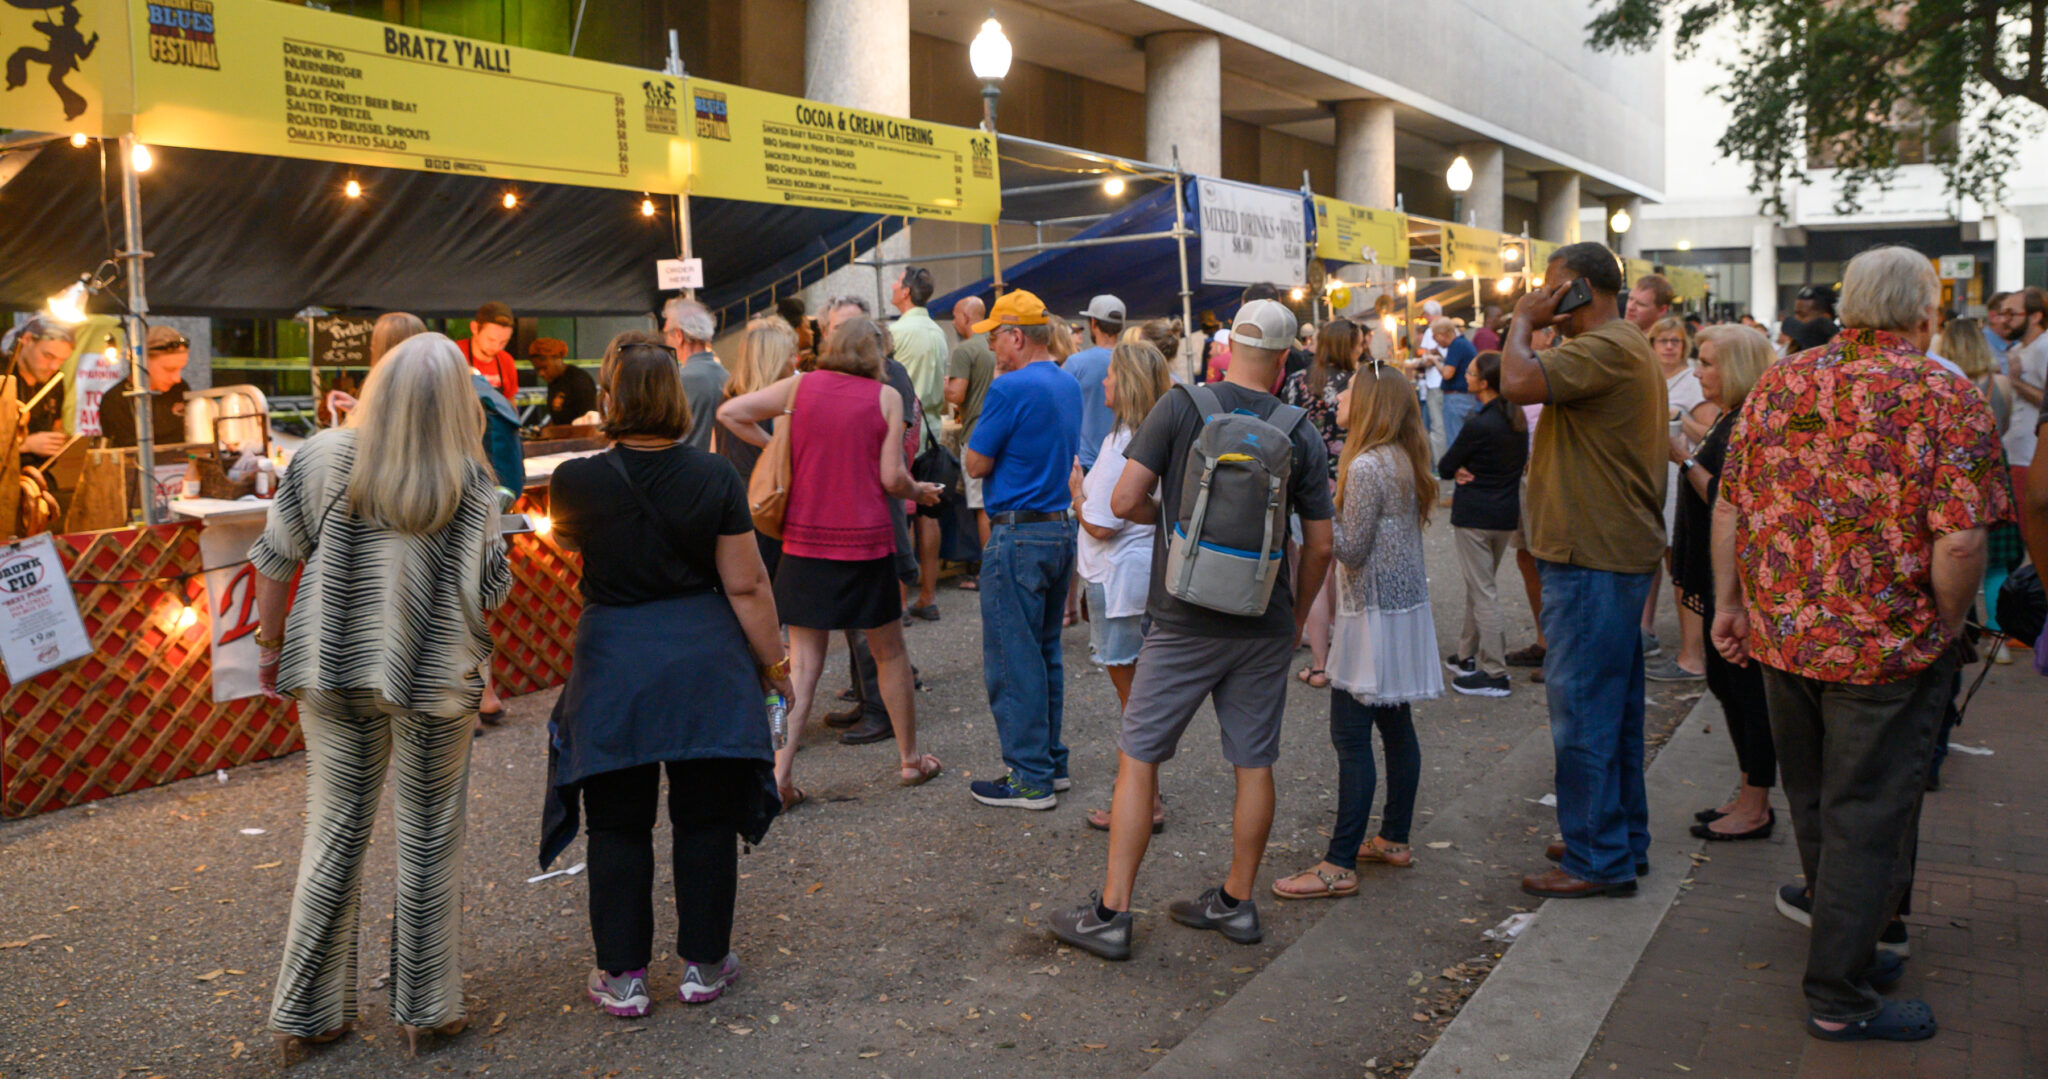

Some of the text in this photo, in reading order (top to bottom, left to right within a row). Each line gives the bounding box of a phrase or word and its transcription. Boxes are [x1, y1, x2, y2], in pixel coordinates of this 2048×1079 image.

[147, 4, 215, 33] BLUES
[150, 34, 220, 71] FESTIVAL
[283, 42, 345, 63] DRUNK PIG
[384, 26, 510, 73] BRATZ Y'ALL!
[284, 57, 363, 79] NUERNBERGER
[285, 70, 345, 90] BAVARIAN
[285, 84, 417, 113] BLACK FOREST BEER BRAT
[286, 98, 373, 121] SALTED PRETZEL
[287, 112, 430, 141] ROASTED BRUSSEL SPROUTS
[762, 124, 788, 136] SMOKED
[796, 104, 934, 146] COCOA & CREAM CATERING
[287, 127, 407, 151] OMA'S POTATO SALAD
[763, 136, 777, 147] BBQ
[764, 149, 790, 161] SMOKED
[792, 153, 812, 164] PULLED
[814, 156, 830, 167] PORK
[765, 162, 779, 174] BBQ
[781, 165, 807, 176] CHICKEN
[766, 176, 792, 187] SMOKED
[1203, 206, 1239, 234] MIXED
[1240, 211, 1276, 240] DRINKS
[665, 266, 695, 274] ORDER
[85, 390, 104, 407] TO
